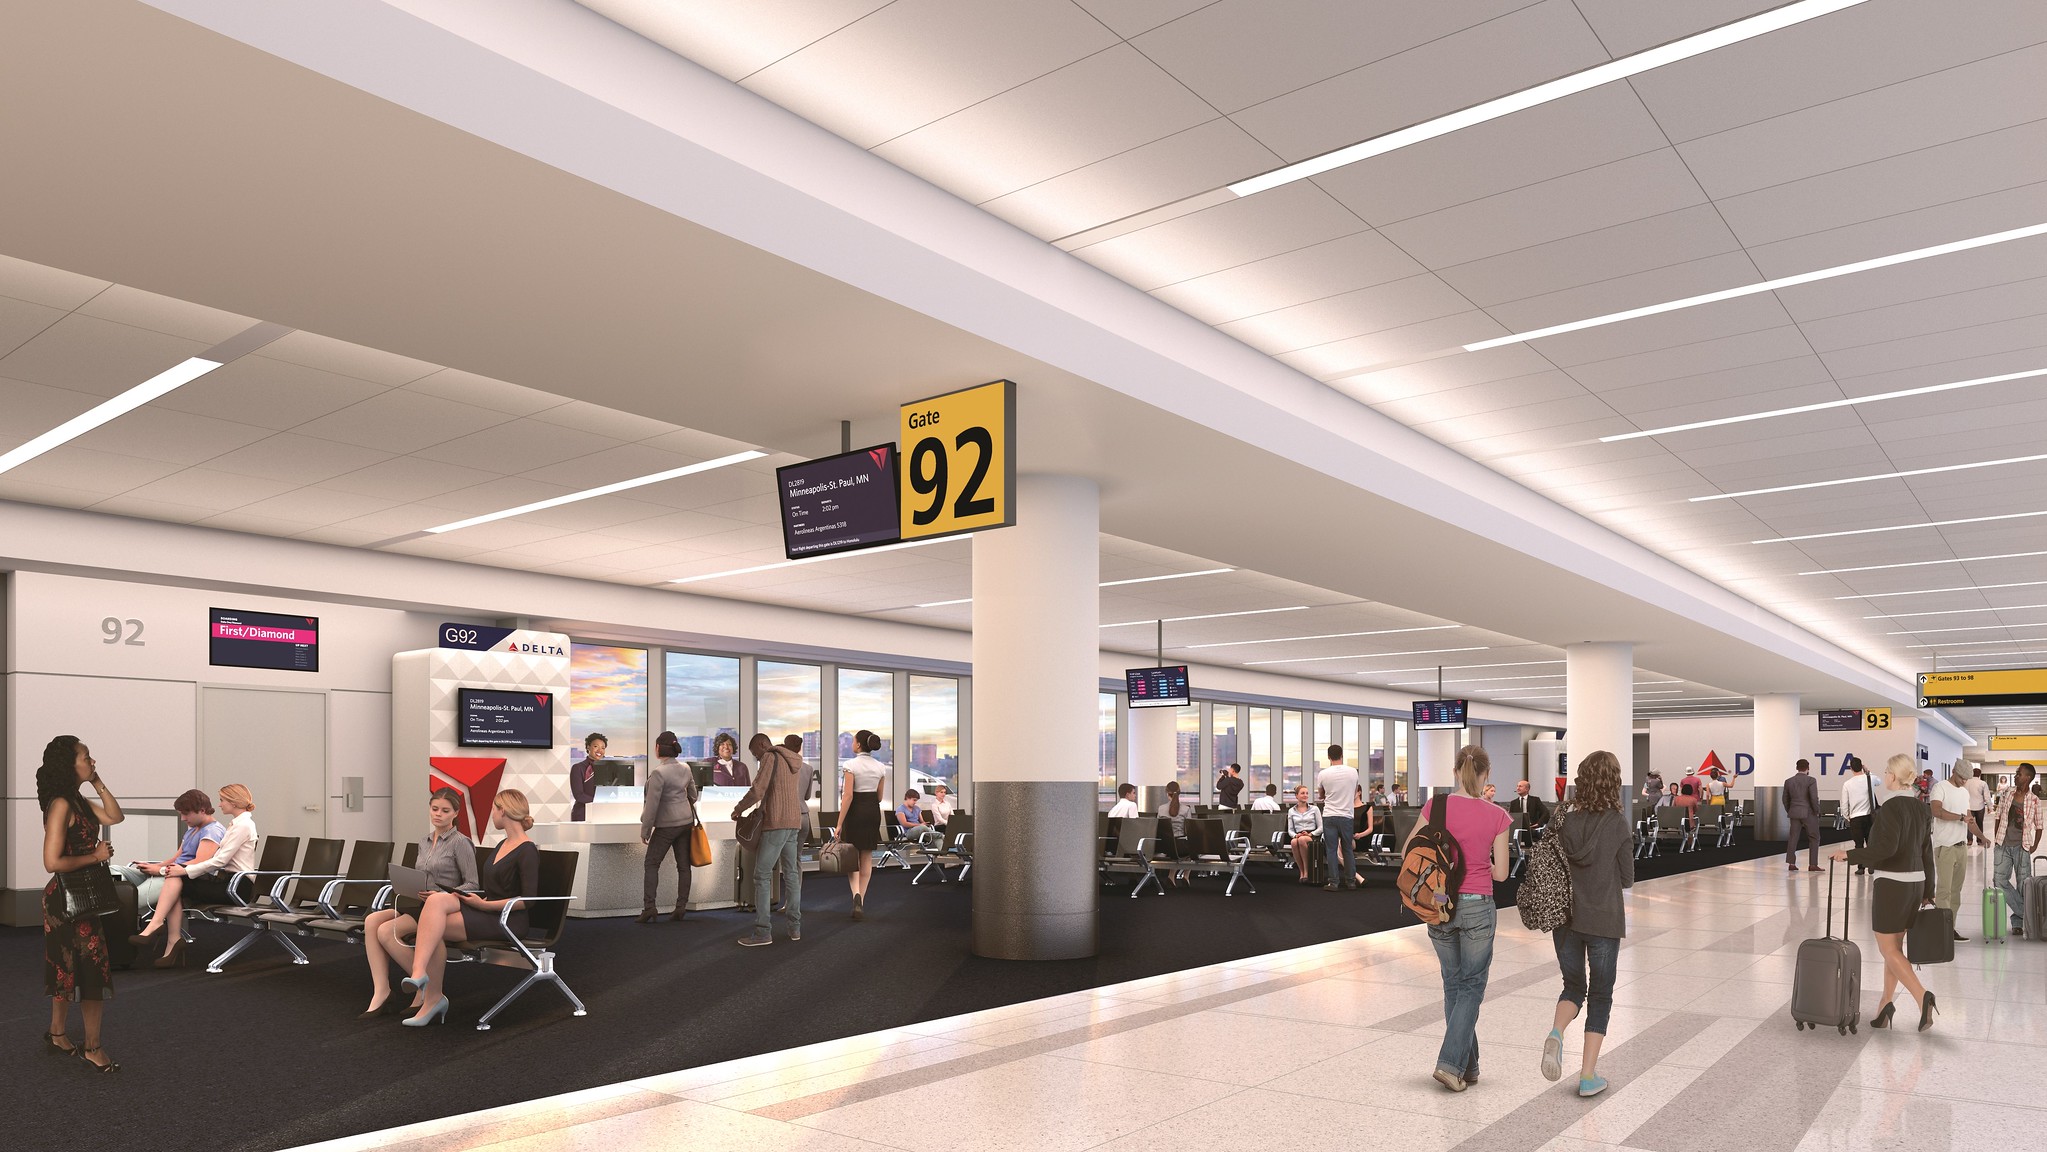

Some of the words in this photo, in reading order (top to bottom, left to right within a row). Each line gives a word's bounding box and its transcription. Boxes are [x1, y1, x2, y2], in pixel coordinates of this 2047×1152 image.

[908, 410, 940, 430] Gate
[790, 481, 838, 498] Minneapolis-St.
[839, 476, 855, 488] Paul,
[856, 474, 870, 484] MN
[909, 426, 995, 526] 92
[102, 616, 146, 646] 92
[220, 626, 295, 640] First/Diamond
[445, 628, 478, 644] G92
[522, 644, 564, 656] DELTA
[1867, 714, 1889, 728] 93
[1735, 753, 1856, 776] DTA
